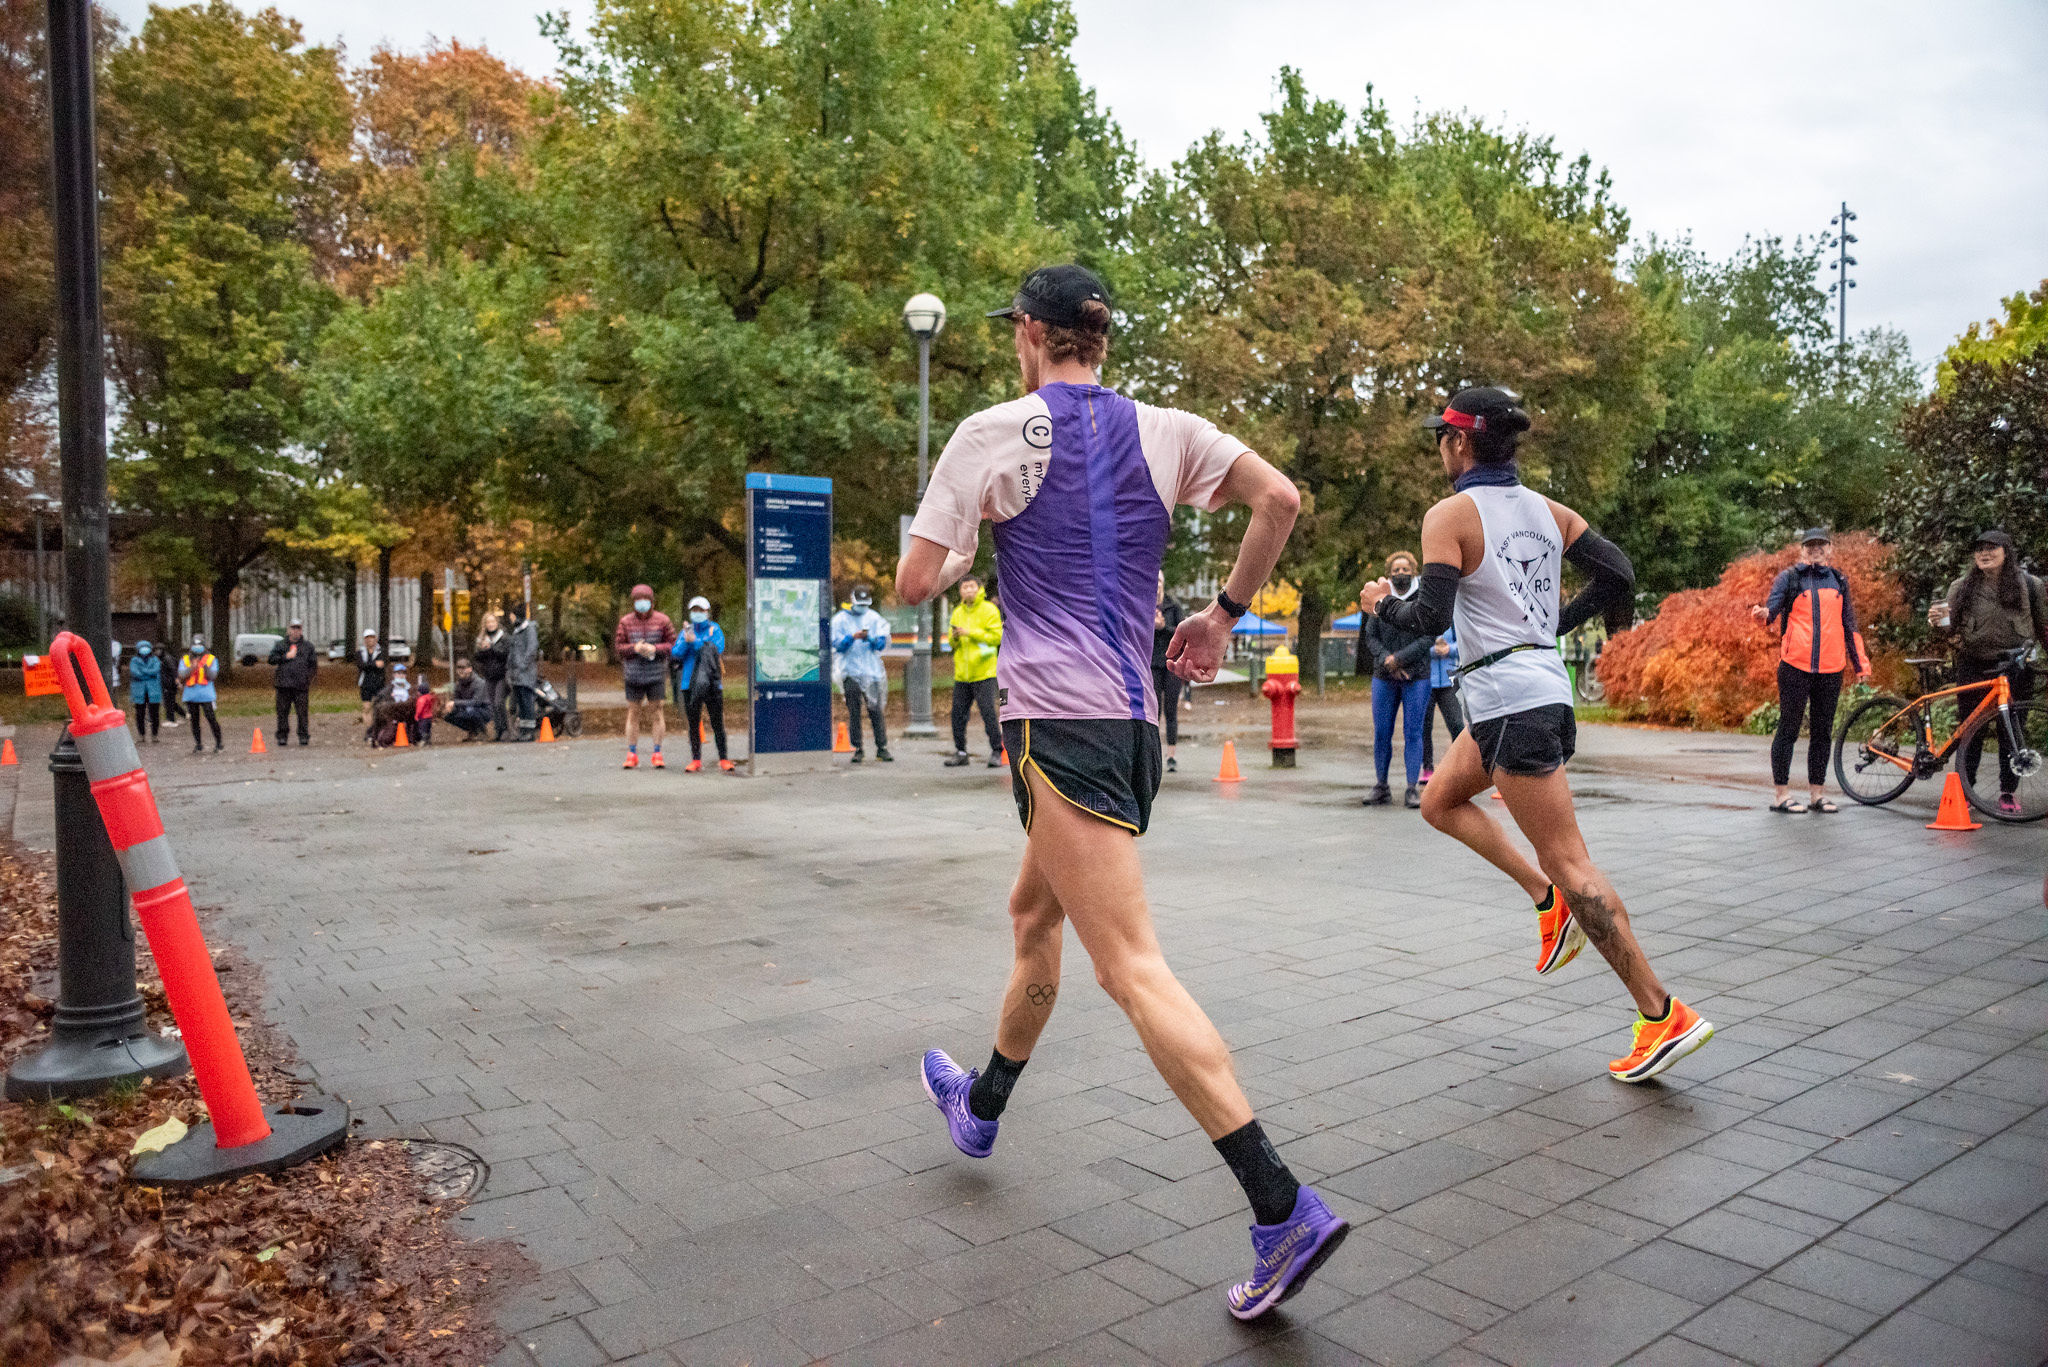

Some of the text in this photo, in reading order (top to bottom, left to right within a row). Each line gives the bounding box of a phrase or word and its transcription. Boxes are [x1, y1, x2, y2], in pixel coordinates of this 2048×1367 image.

[1033, 462, 1044, 480] my
[1496, 530, 1557, 559] EAST VANCOUVER
[1534, 577, 1551, 593] RC
